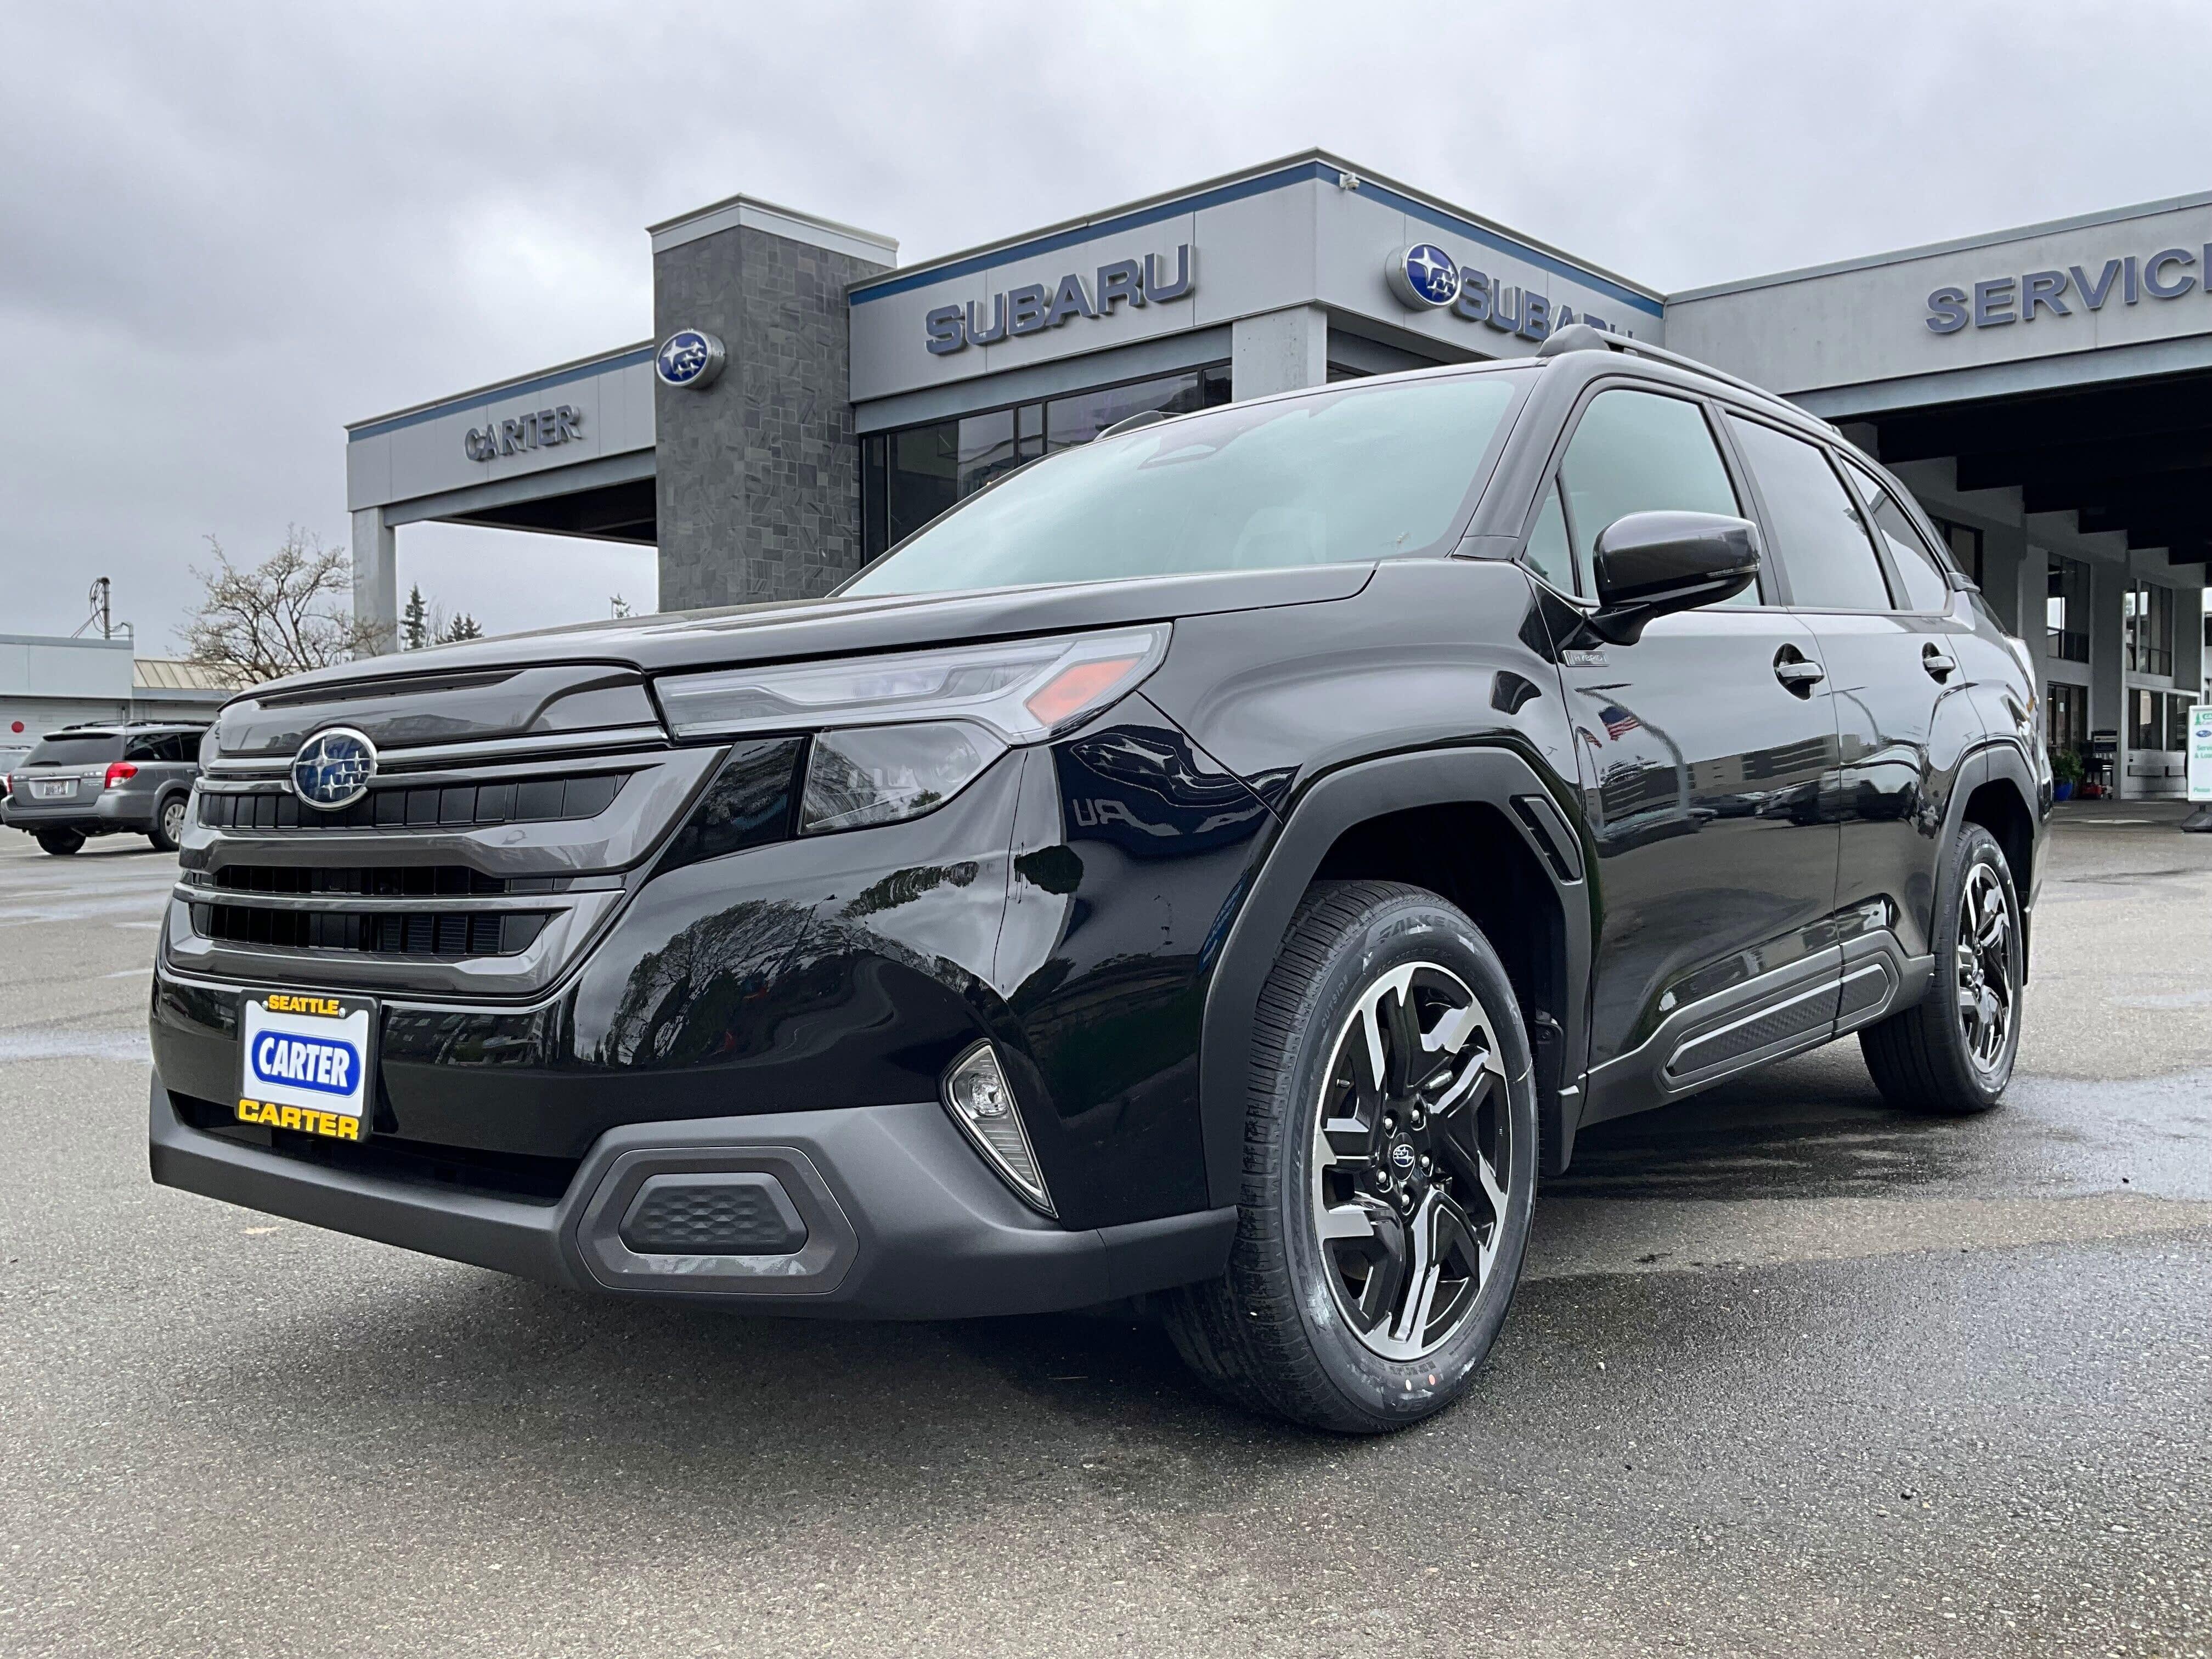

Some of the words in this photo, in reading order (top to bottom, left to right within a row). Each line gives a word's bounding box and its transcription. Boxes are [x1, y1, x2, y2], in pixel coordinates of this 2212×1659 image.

[926, 243, 1194, 356] SUBARU
[1454, 266, 1633, 341] SUBA
[1925, 243, 2212, 334] SERVIC
[465, 404, 582, 461] CARTER
[268, 995, 340, 1015] SEATTLE
[259, 1037, 350, 1087] CARTER
[238, 1099, 359, 1140] CARTER
